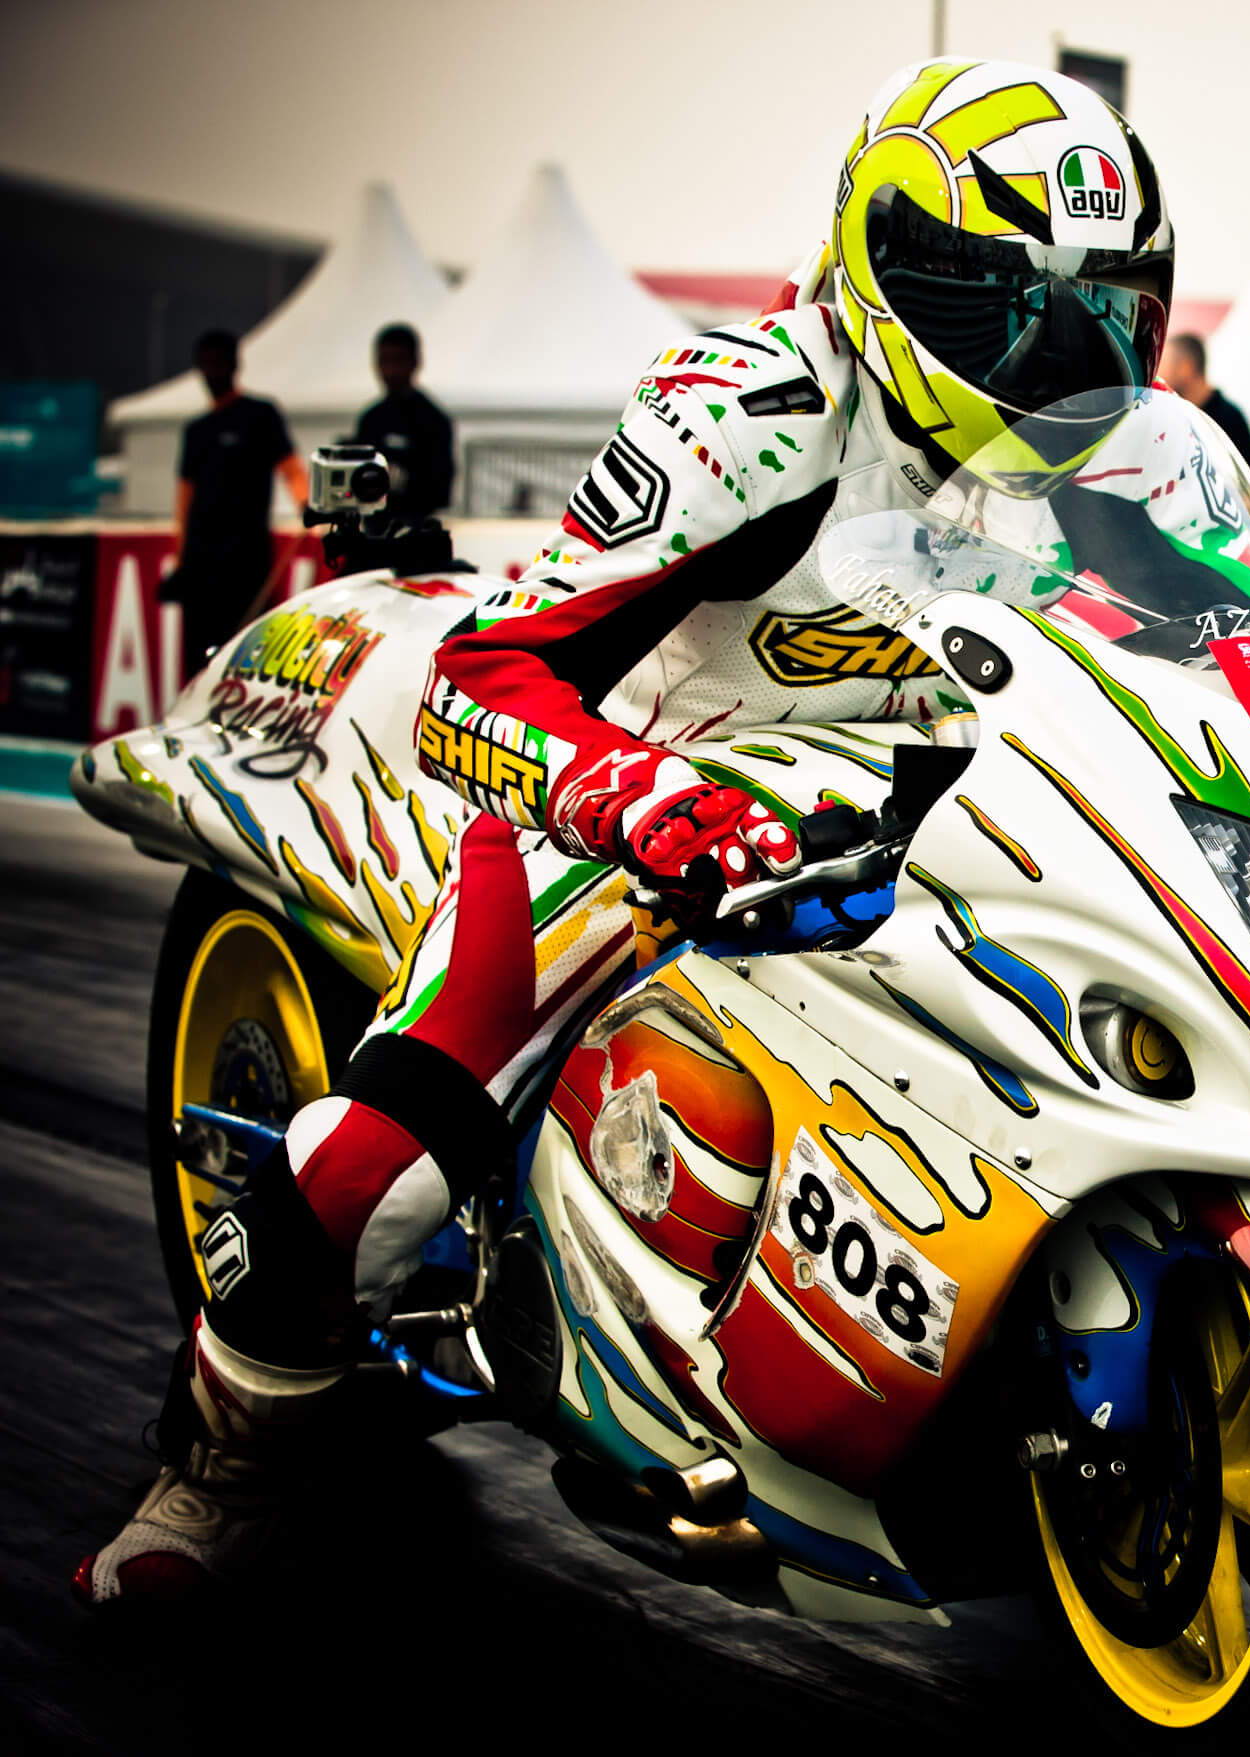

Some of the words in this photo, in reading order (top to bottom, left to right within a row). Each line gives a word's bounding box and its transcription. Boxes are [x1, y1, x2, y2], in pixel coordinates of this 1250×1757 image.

[1071, 189, 1120, 219] agv
[205, 677, 333, 779] Racing
[419, 706, 545, 808] SHIFT
[789, 1171, 930, 1343] 808
